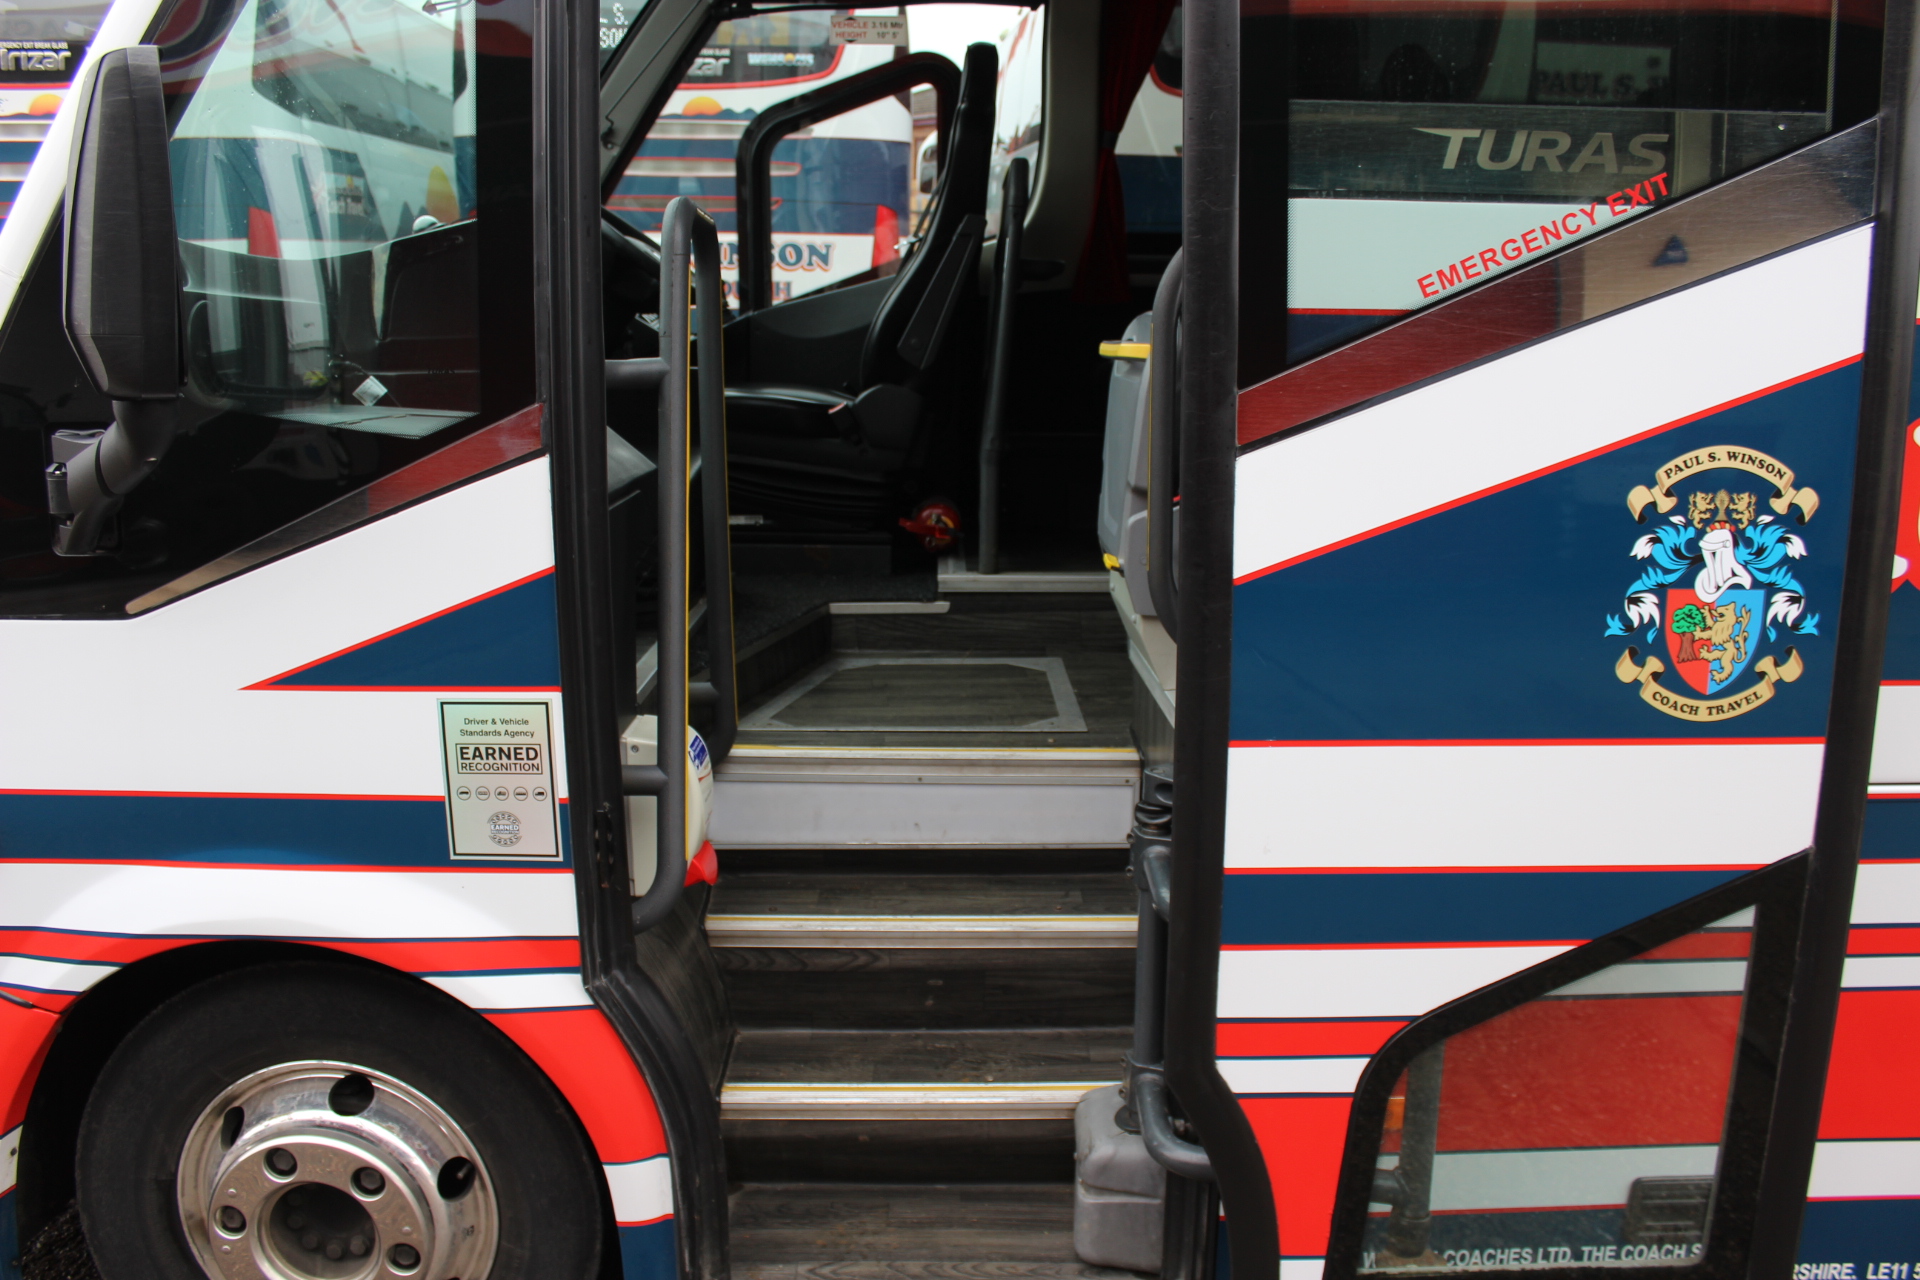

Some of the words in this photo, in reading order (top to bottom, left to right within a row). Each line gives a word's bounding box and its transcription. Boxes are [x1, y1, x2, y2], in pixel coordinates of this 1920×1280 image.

[832, 21, 868, 29] VEHICLE
[871, 21, 889, 29] 3.16
[835, 31, 867, 39] HEIGHT
[1412, 127, 1670, 174] TURAS
[1416, 202, 1598, 299] EMERGENCY
[1605, 172, 1669, 217] EXIT
[1664, 455, 1704, 480] PAUL
[1707, 452, 1721, 462] S.
[1726, 451, 1787, 480] WINSON
[1652, 691, 1700, 716] COACH
[1706, 691, 1763, 716] TRAVEL
[463, 718, 489, 726] Driver
[491, 718, 497, 726] &
[499, 718, 530, 726] Vehicle
[459, 729, 502, 737] Standards
[503, 729, 535, 738] Agency
[459, 746, 539, 761] EARNED
[460, 762, 540, 772] RECOGNITION
[1443, 1248, 1533, 1266] COACHES
[1537, 1247, 1575, 1264] LTD.
[1581, 1246, 1618, 1262] THE
[1620, 1244, 1687, 1261] COACH
[1866, 1262, 1909, 1280] LE11
